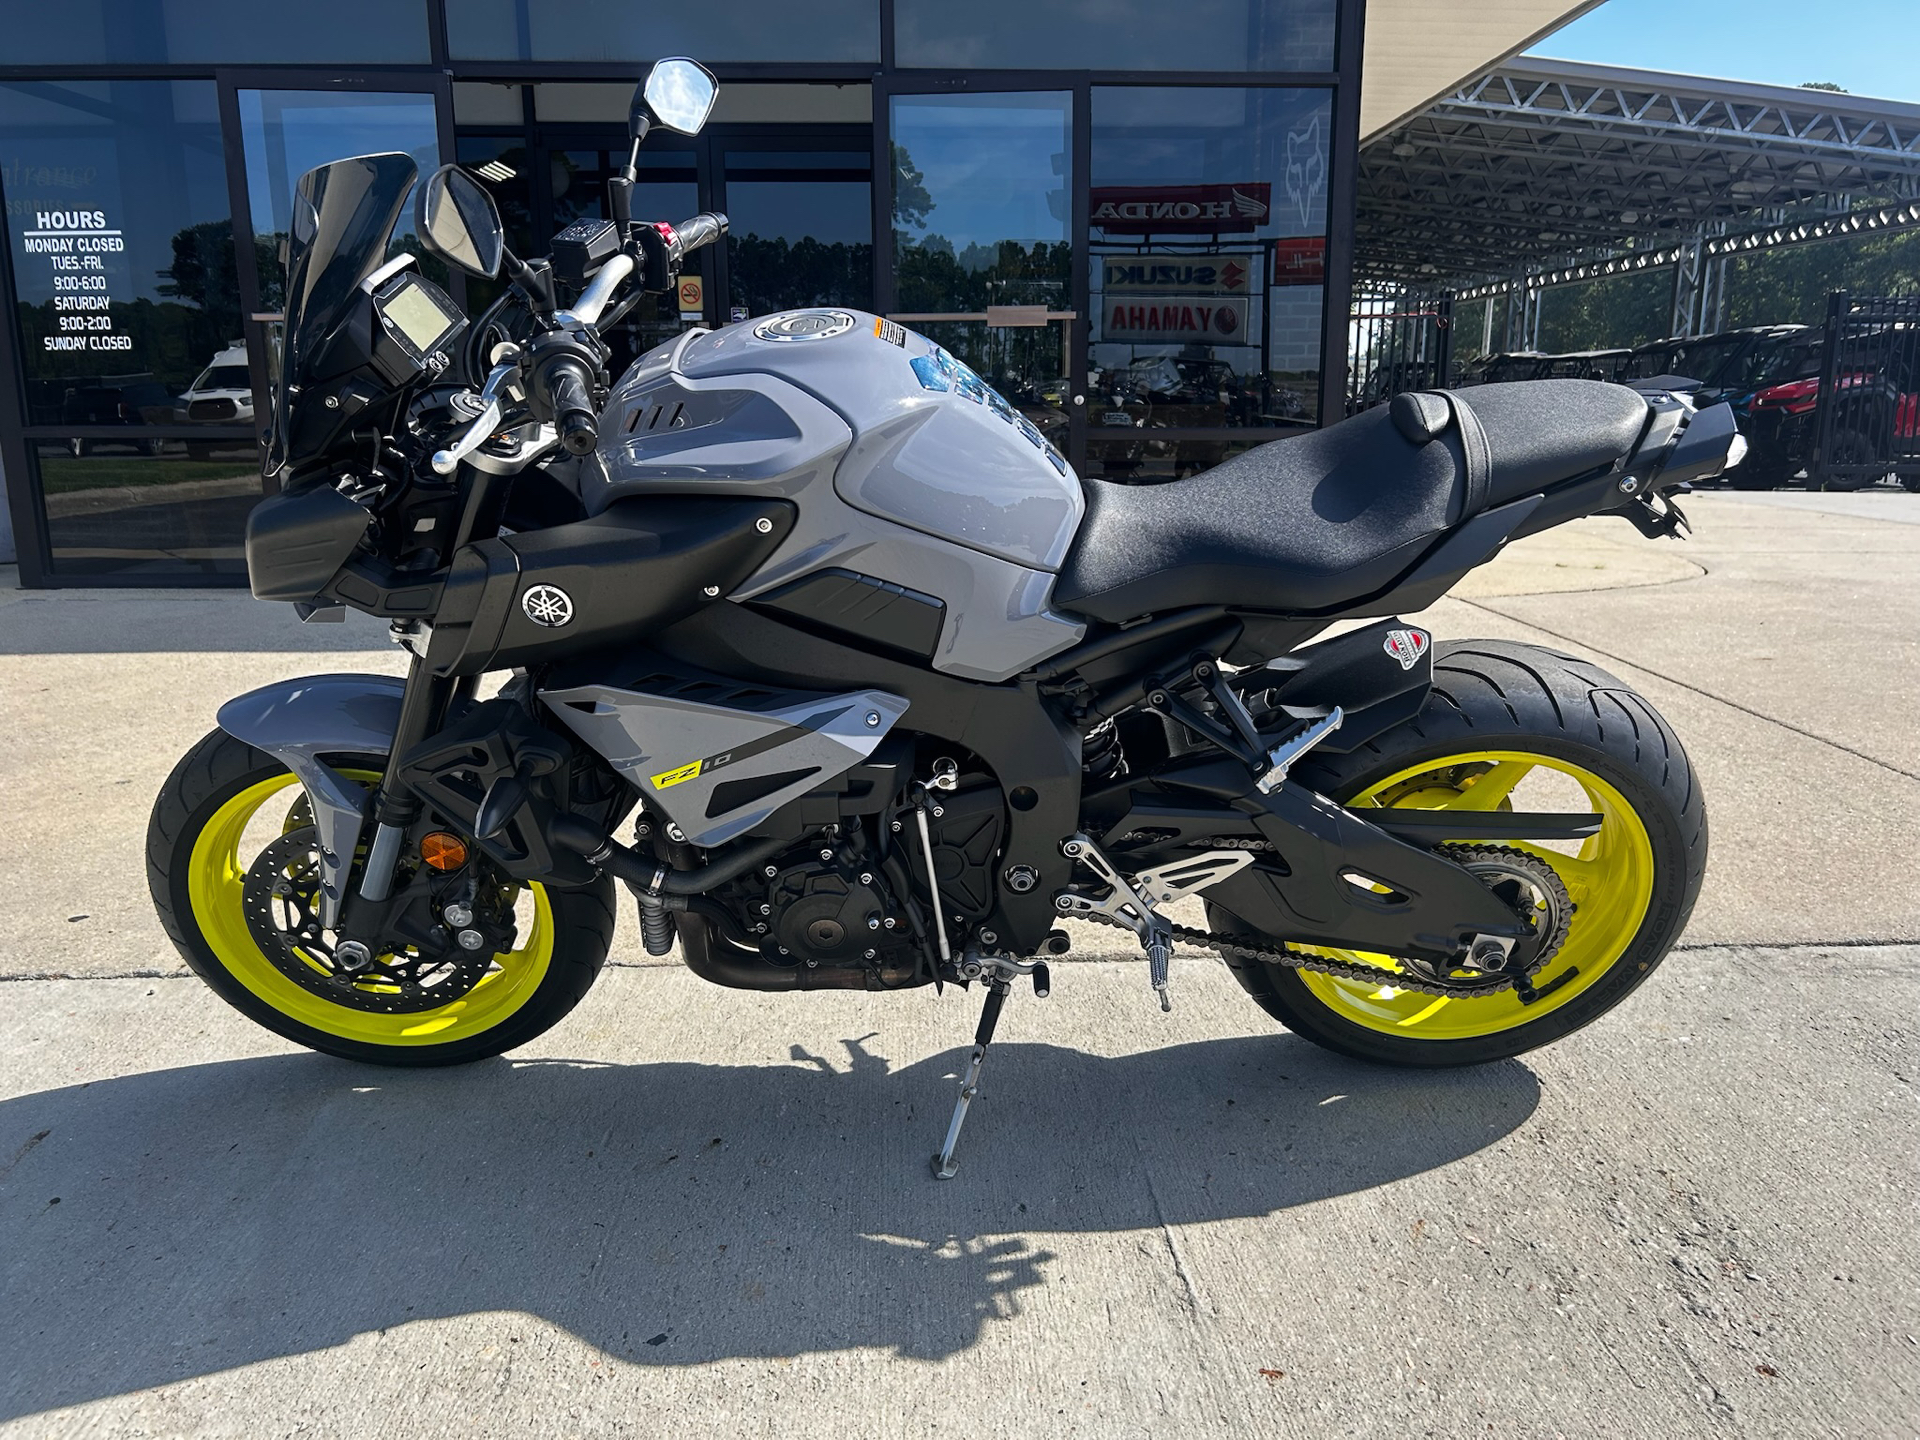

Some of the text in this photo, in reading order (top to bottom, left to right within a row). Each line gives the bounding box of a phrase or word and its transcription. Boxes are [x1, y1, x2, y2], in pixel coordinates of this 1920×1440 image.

[36, 211, 106, 229] HOURS
[24, 238, 124, 253] MONDAY CLOSED
[54, 276, 106, 291] 9:00-6:00
[54, 296, 110, 310] SATURDAY
[59, 316, 112, 330] 9:00-2:00
[44, 336, 132, 350] SUNDAY CLOSED
